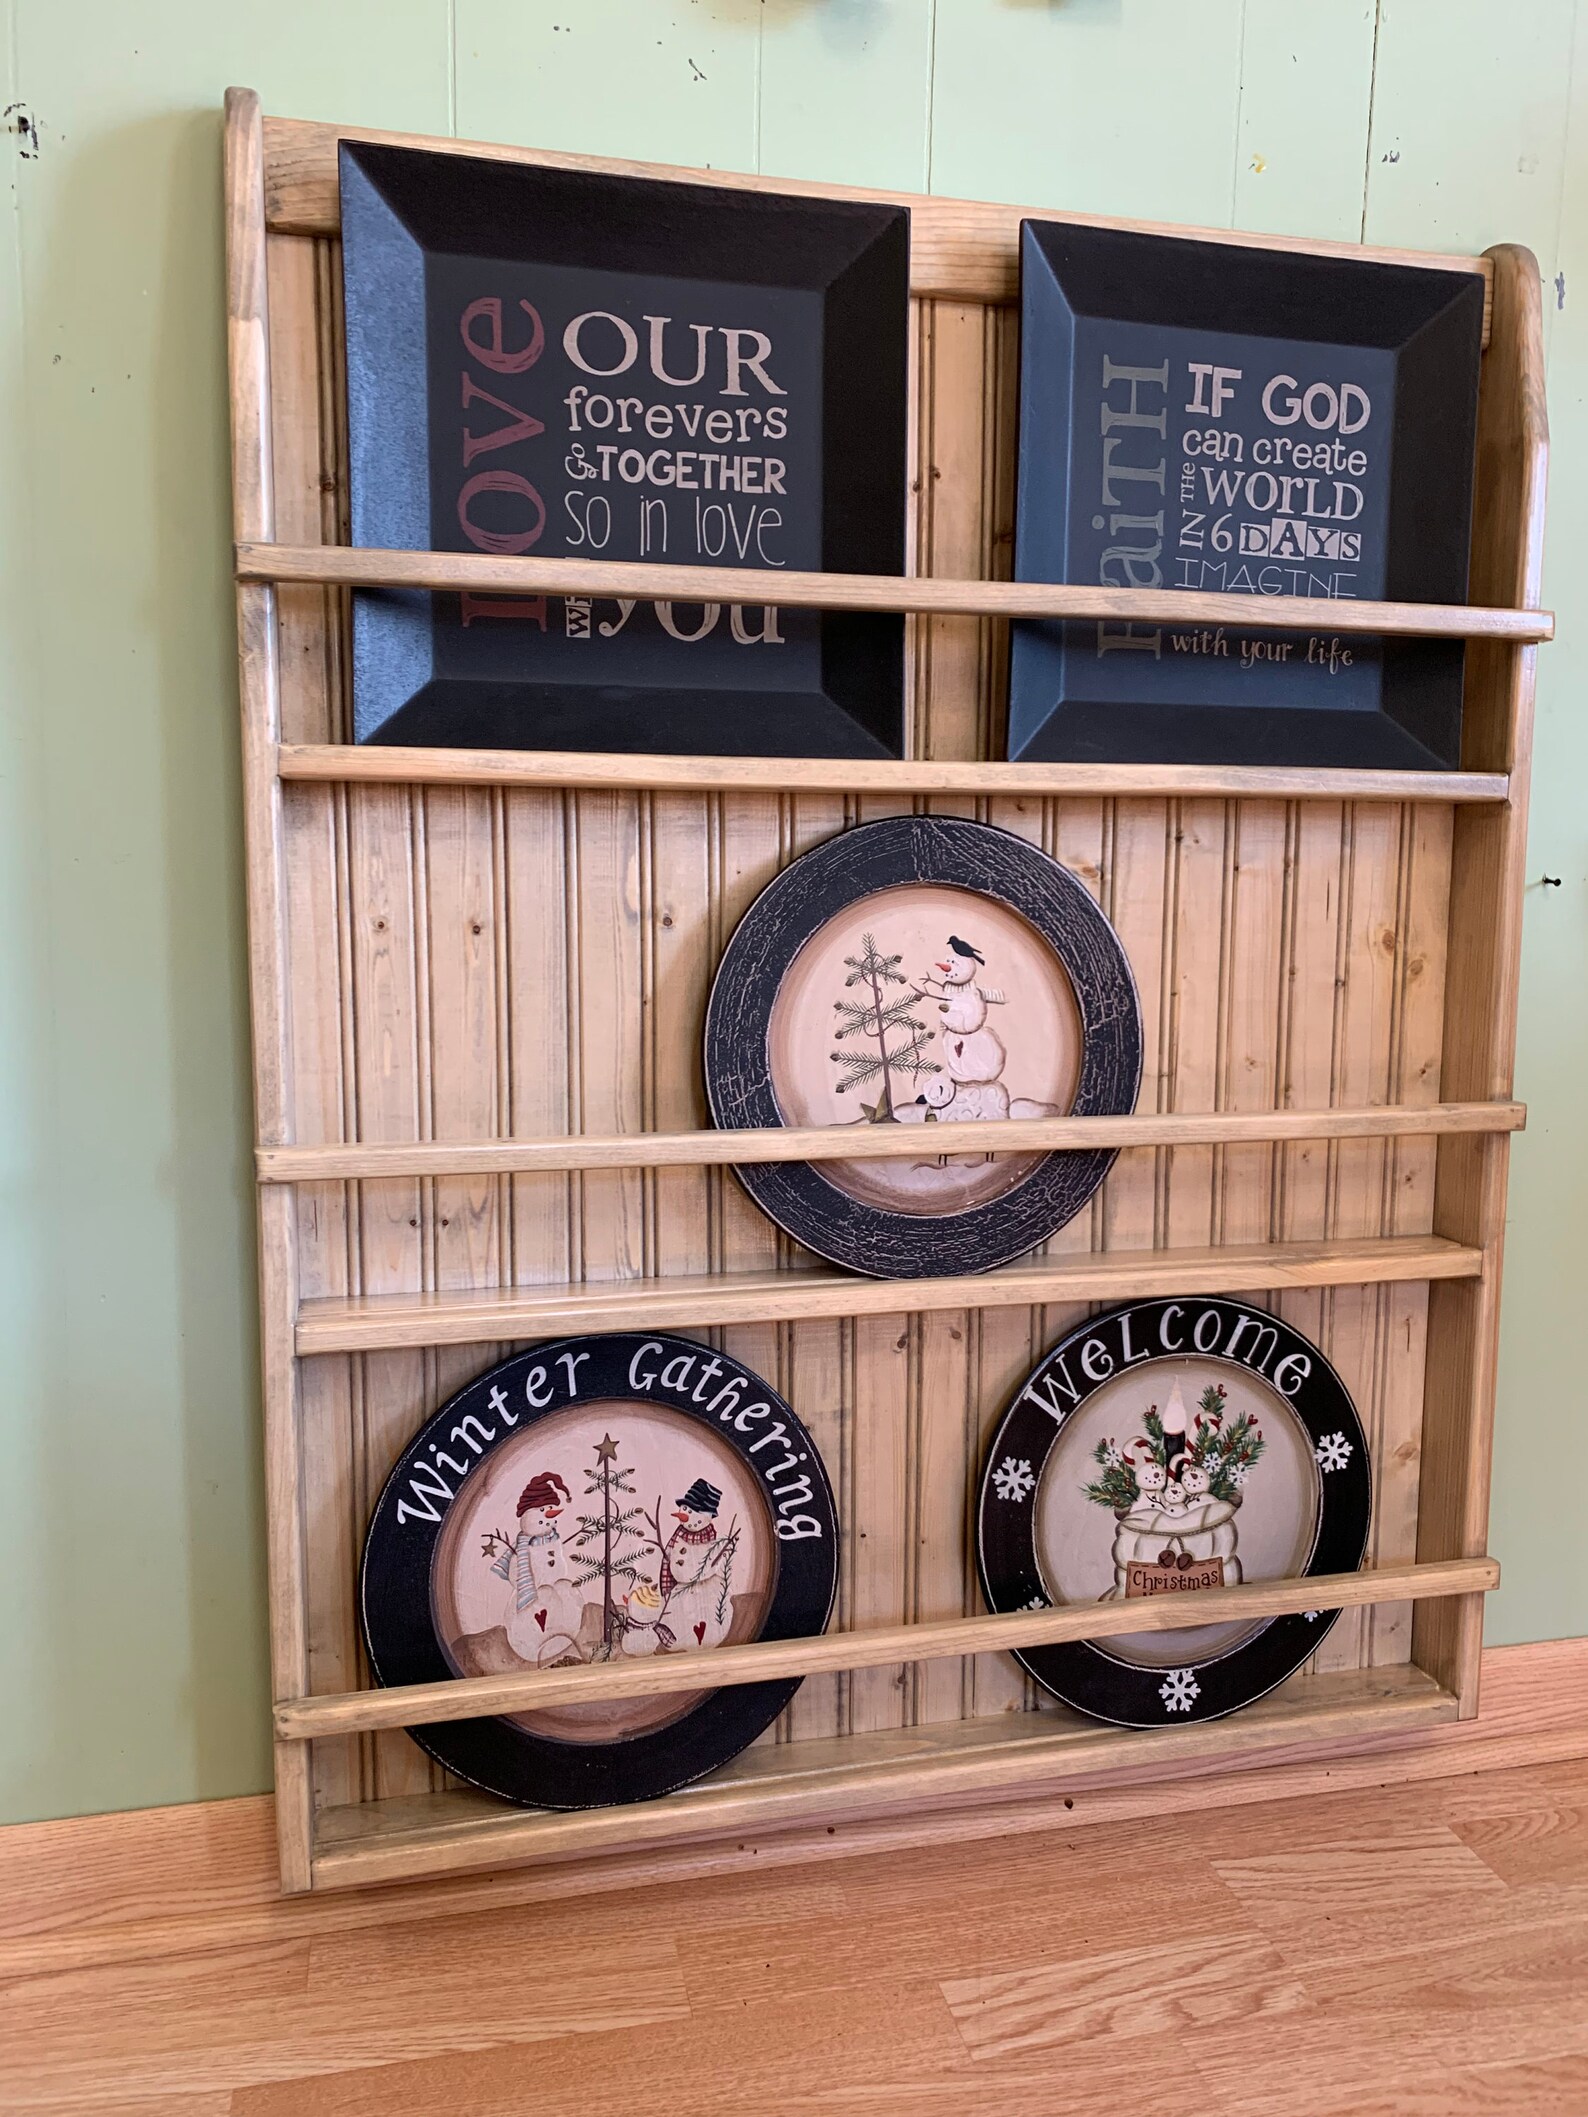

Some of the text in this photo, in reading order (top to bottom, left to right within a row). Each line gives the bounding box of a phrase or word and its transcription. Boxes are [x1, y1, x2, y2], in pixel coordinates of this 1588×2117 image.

[563, 311, 788, 396] OUR
[563, 385, 788, 444] forevers
[1185, 362, 1371, 434] IF GOD
[596, 444, 787, 495] TOGETHER
[1182, 428, 1368, 476] can create
[640, 495, 668, 556] in
[696, 496, 786, 566] love
[1179, 508, 1362, 562] IN 6 DAYS
[1174, 557, 1357, 599] IMAGINE
[1170, 627, 1353, 675] with your life
[396, 1341, 823, 1542] Winter Gathering
[1133, 1569, 1219, 1591] Christmas
